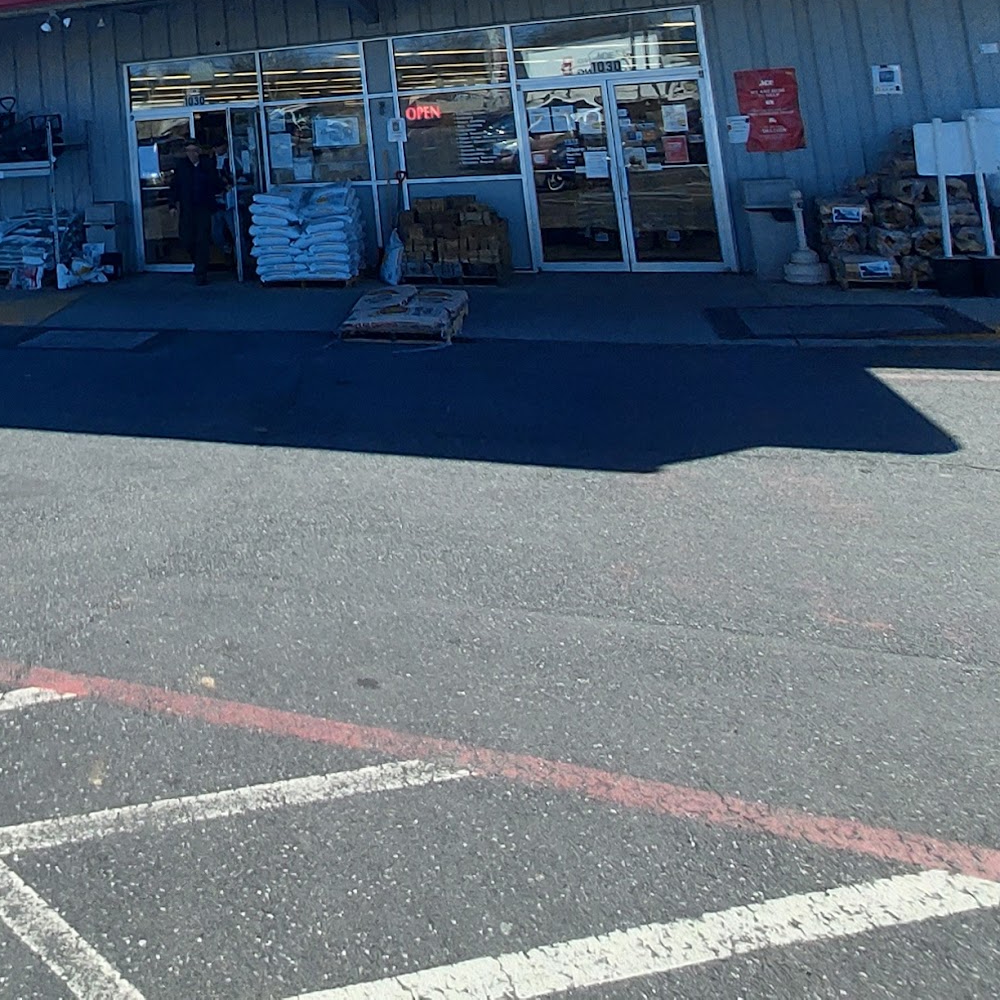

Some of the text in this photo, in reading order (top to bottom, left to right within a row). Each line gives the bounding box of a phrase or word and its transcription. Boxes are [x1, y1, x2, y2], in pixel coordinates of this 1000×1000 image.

[591, 60, 621, 73] 1030
[185, 95, 205, 106] 1030
[405, 104, 442, 120] OPEN
